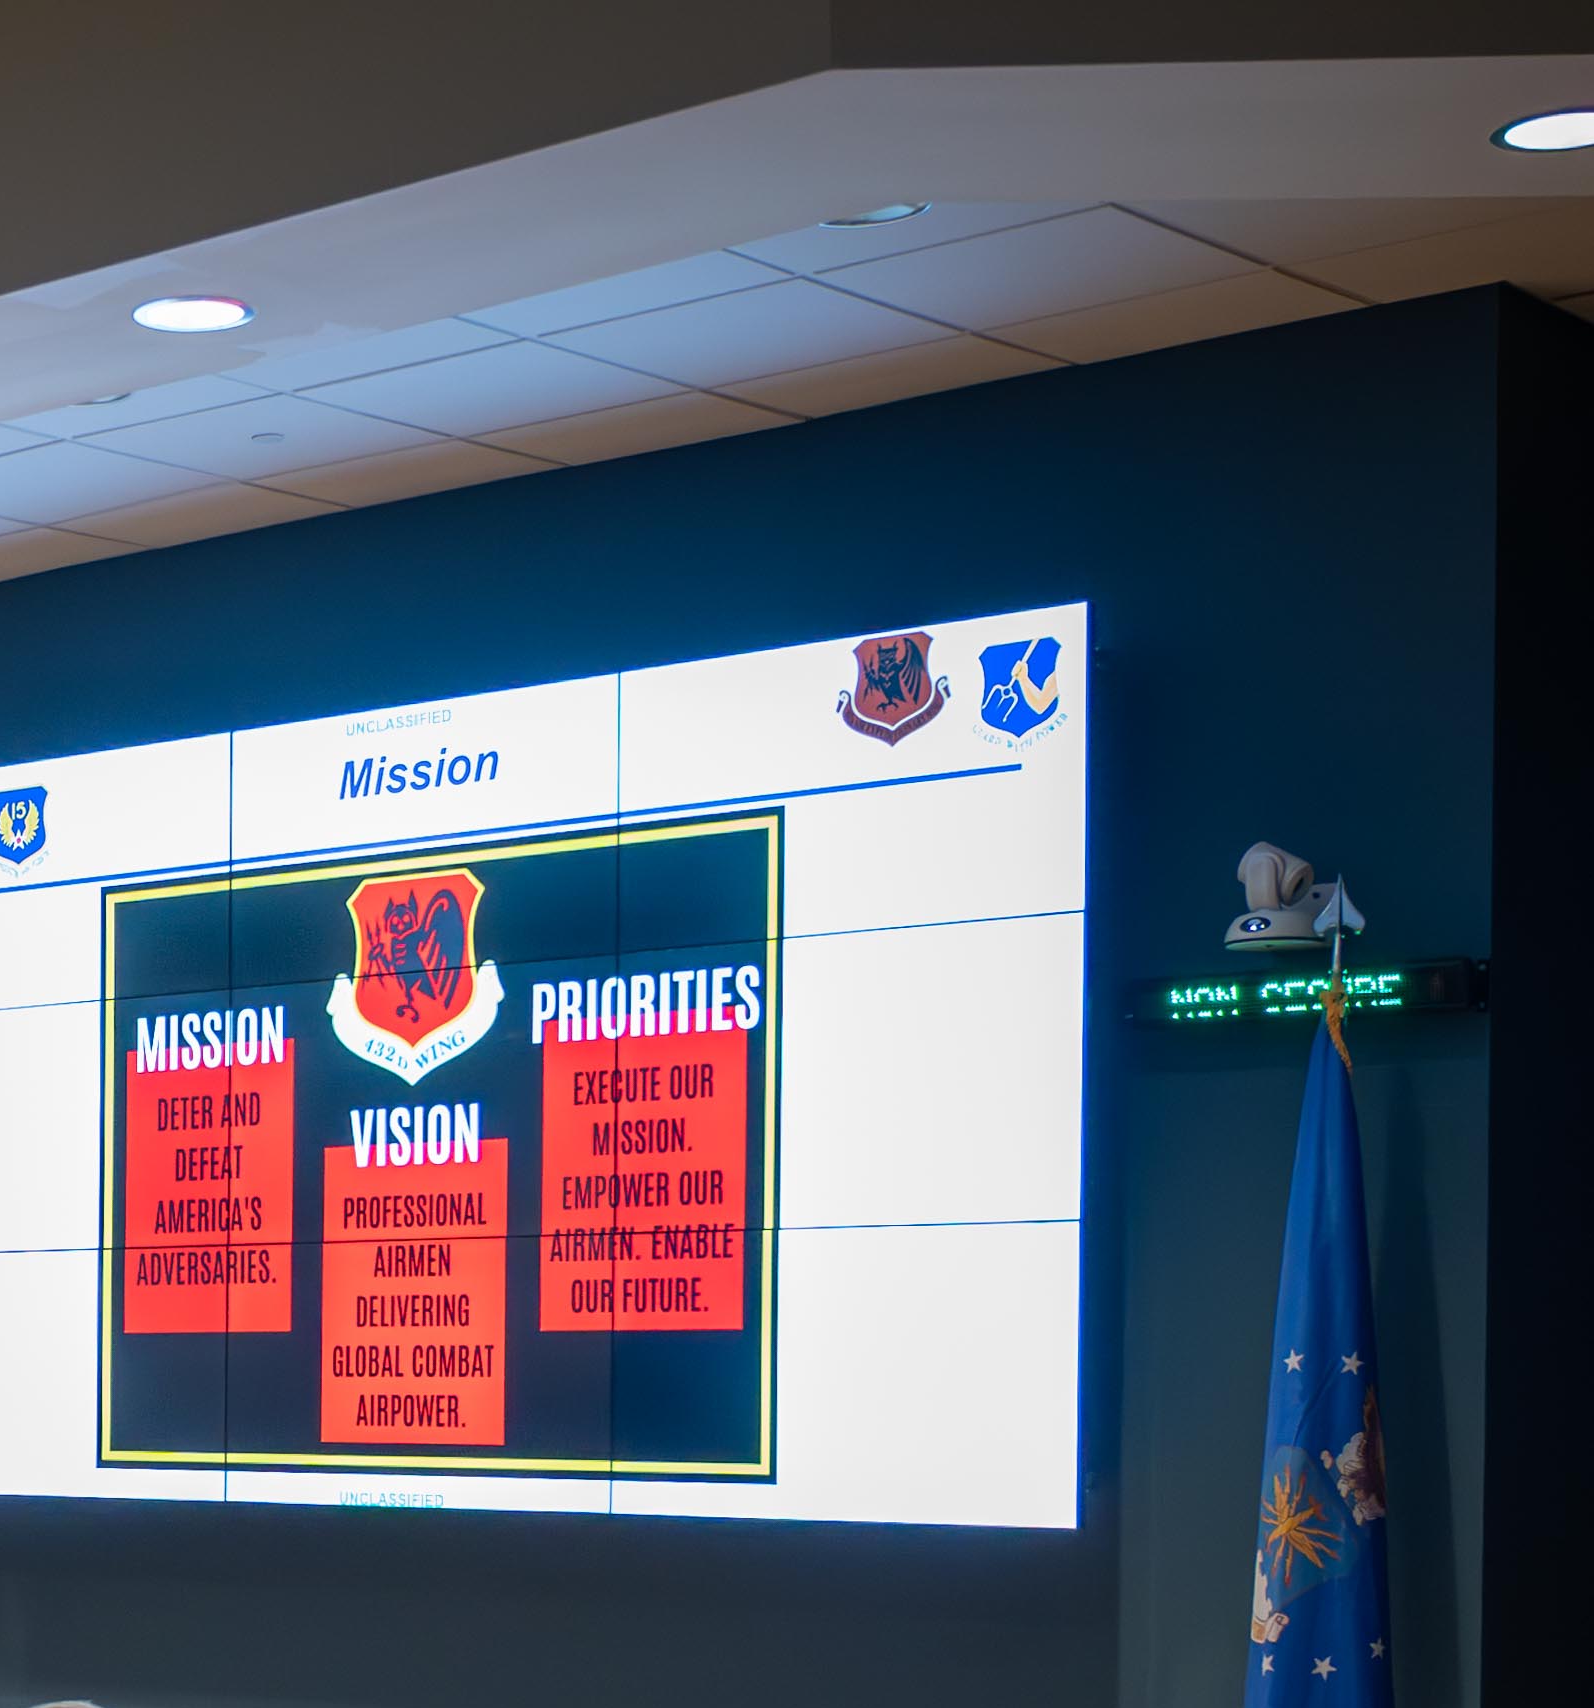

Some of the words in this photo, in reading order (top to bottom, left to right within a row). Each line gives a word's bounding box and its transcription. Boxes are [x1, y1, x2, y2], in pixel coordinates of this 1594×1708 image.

[346, 709, 452, 736] UNCLASSIFIED
[339, 747, 499, 800] Mission
[11, 801, 27, 820] 15
[532, 965, 761, 1044] PRIORITIES
[136, 1006, 284, 1073] MISSION
[415, 1030, 466, 1070] WING
[573, 1066, 661, 1106] EXECUTE
[670, 1063, 714, 1100] OUR
[157, 1095, 213, 1131] DETER
[220, 1092, 261, 1128] AND
[350, 1103, 480, 1168] VISION
[175, 1145, 243, 1182] DEFEAT
[562, 1173, 670, 1210] EMPOWER
[679, 1170, 724, 1205] OUR
[154, 1197, 262, 1235] AMERICA'S
[343, 1192, 487, 1230] PROFESSIONAL
[373, 1243, 451, 1278] AIRMEN
[549, 1226, 641, 1263] AIRMEN.
[652, 1223, 735, 1260] ENABLE
[136, 1250, 277, 1286] ADVERSARIES.
[356, 1294, 470, 1327] DELIVERING
[571, 1279, 613, 1314] OUR
[622, 1277, 709, 1313] FUTURE.
[332, 1345, 404, 1378] GLOBAL
[412, 1344, 495, 1378] COMBAT
[356, 1394, 467, 1428] AIRPOWER.
[339, 1490, 444, 1509] UNCLASSIFIED
